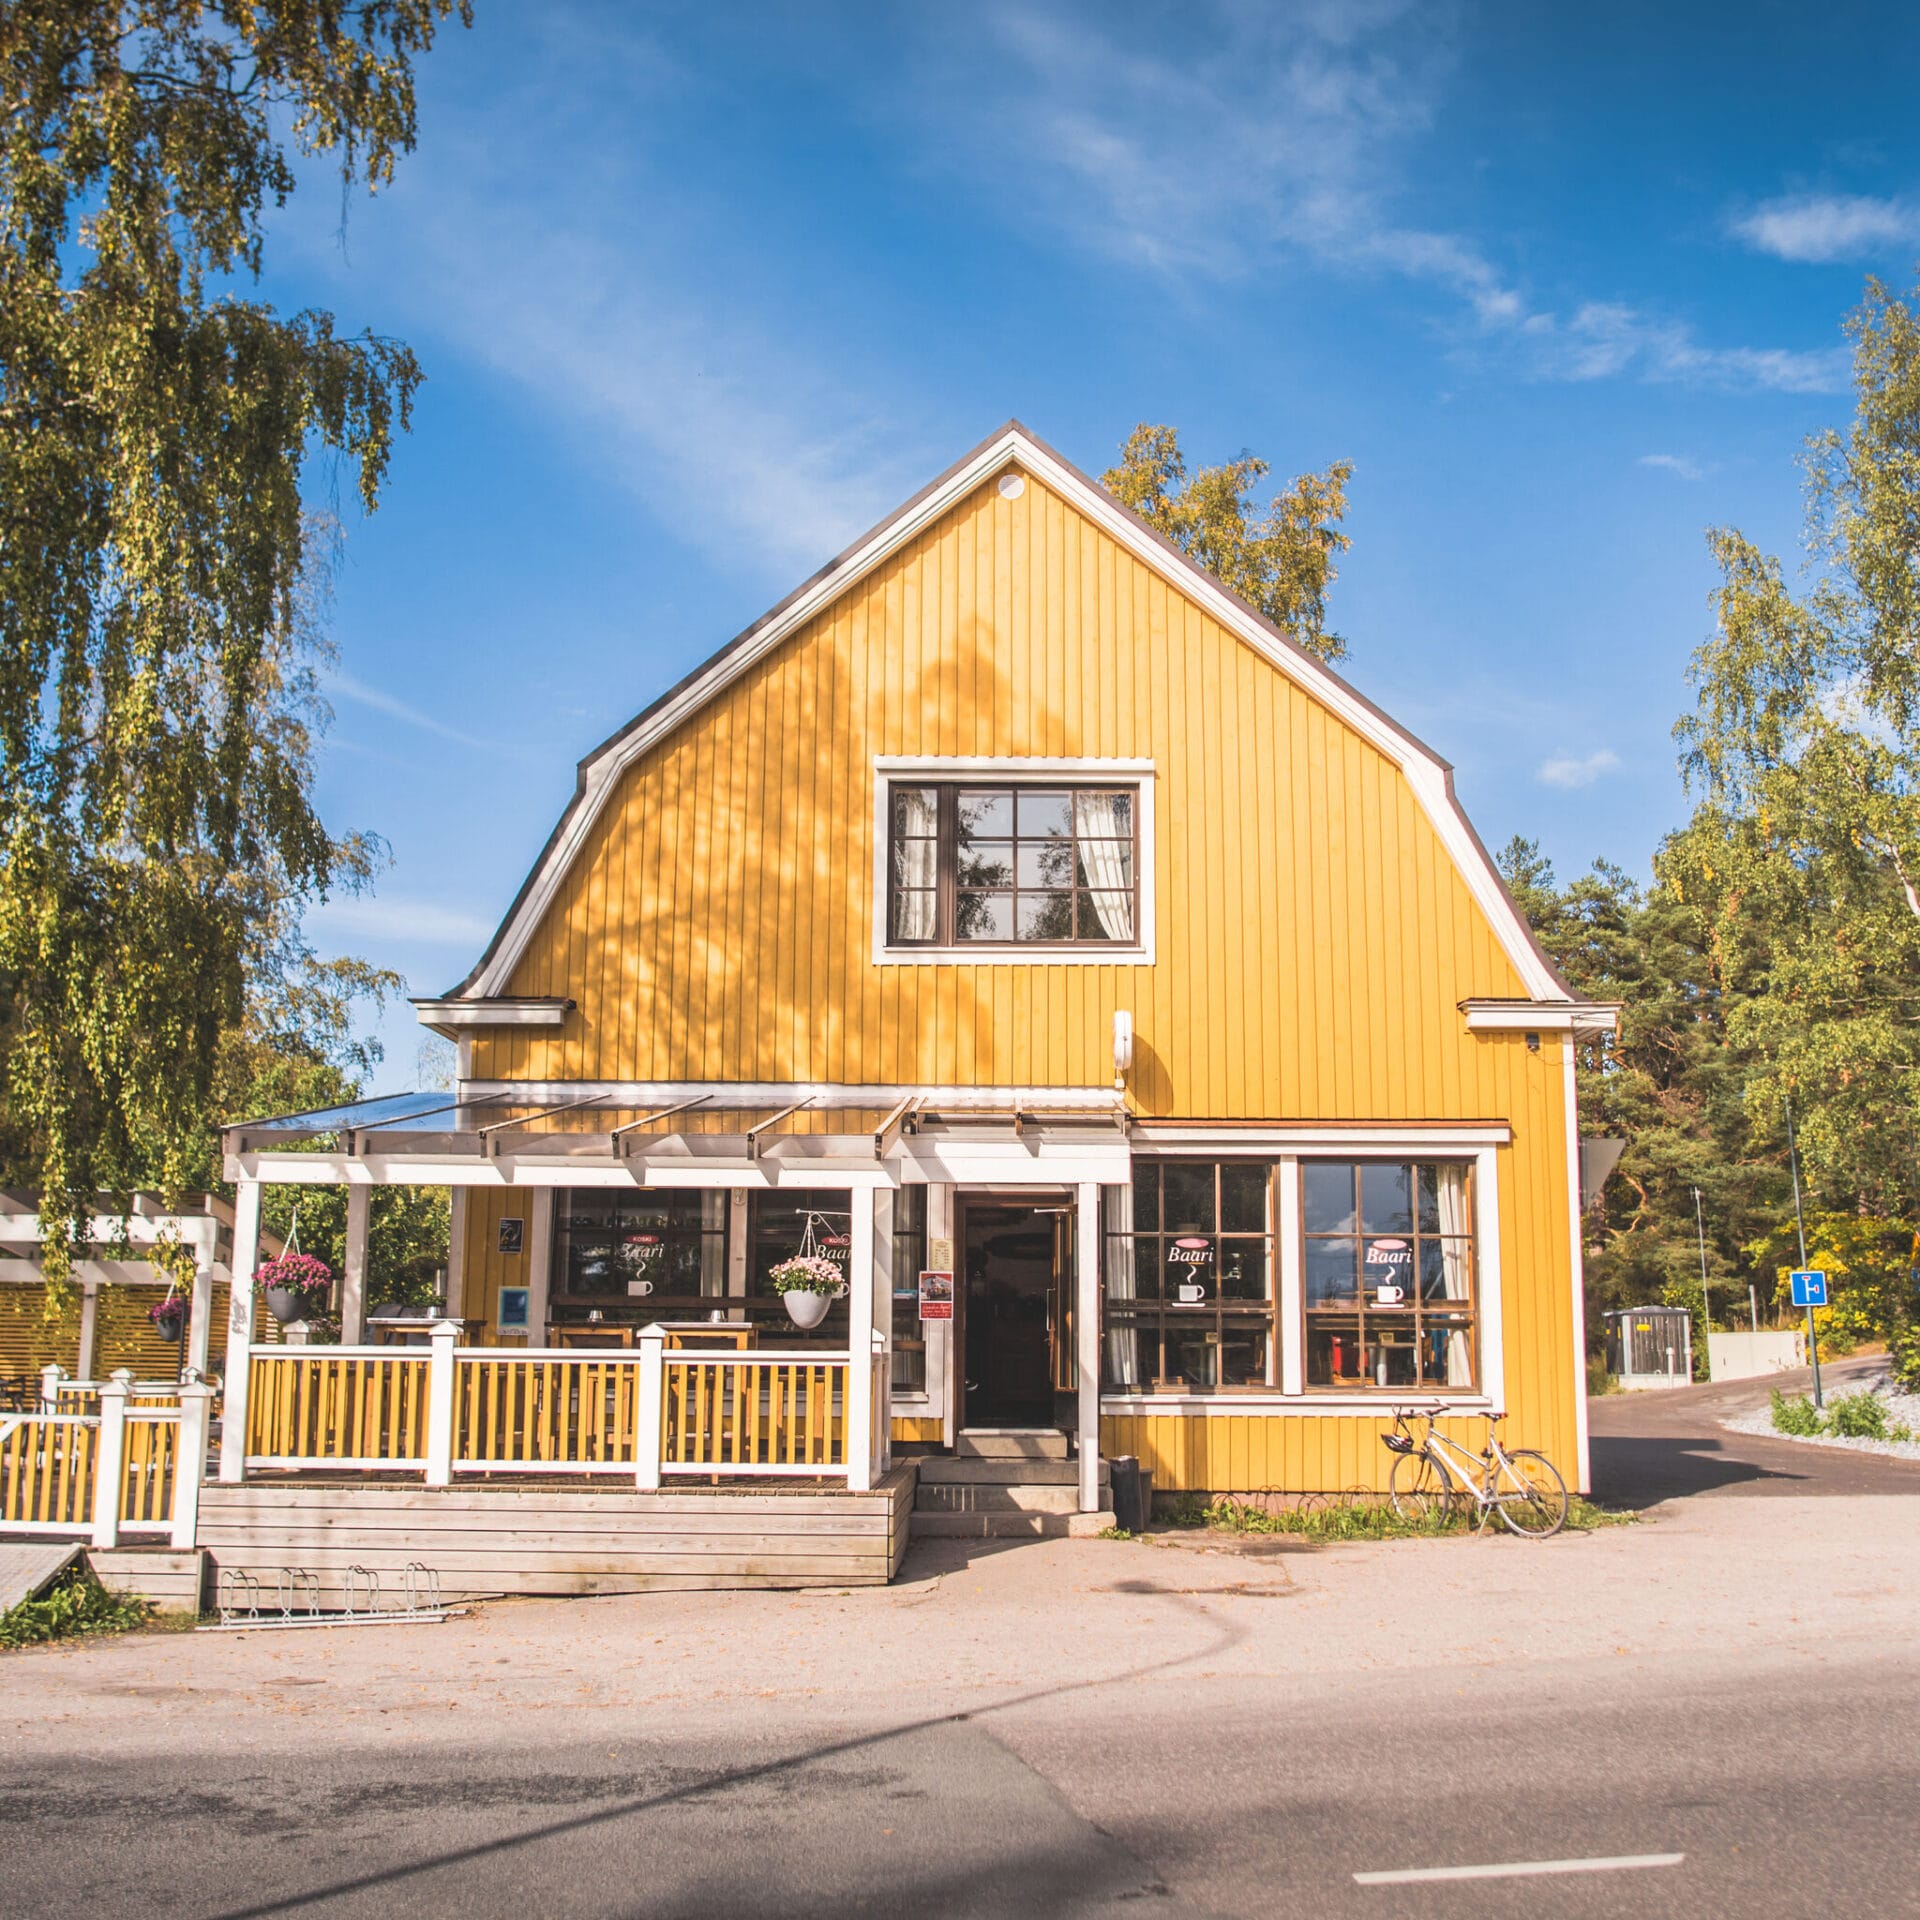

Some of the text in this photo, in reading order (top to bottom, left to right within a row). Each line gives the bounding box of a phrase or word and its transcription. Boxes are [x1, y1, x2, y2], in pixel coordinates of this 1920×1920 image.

[620, 1243, 664, 1258] Baari
[817, 1244, 851, 1259] Baar
[1167, 1246, 1214, 1263] Baari
[1365, 1247, 1413, 1264] Baari
